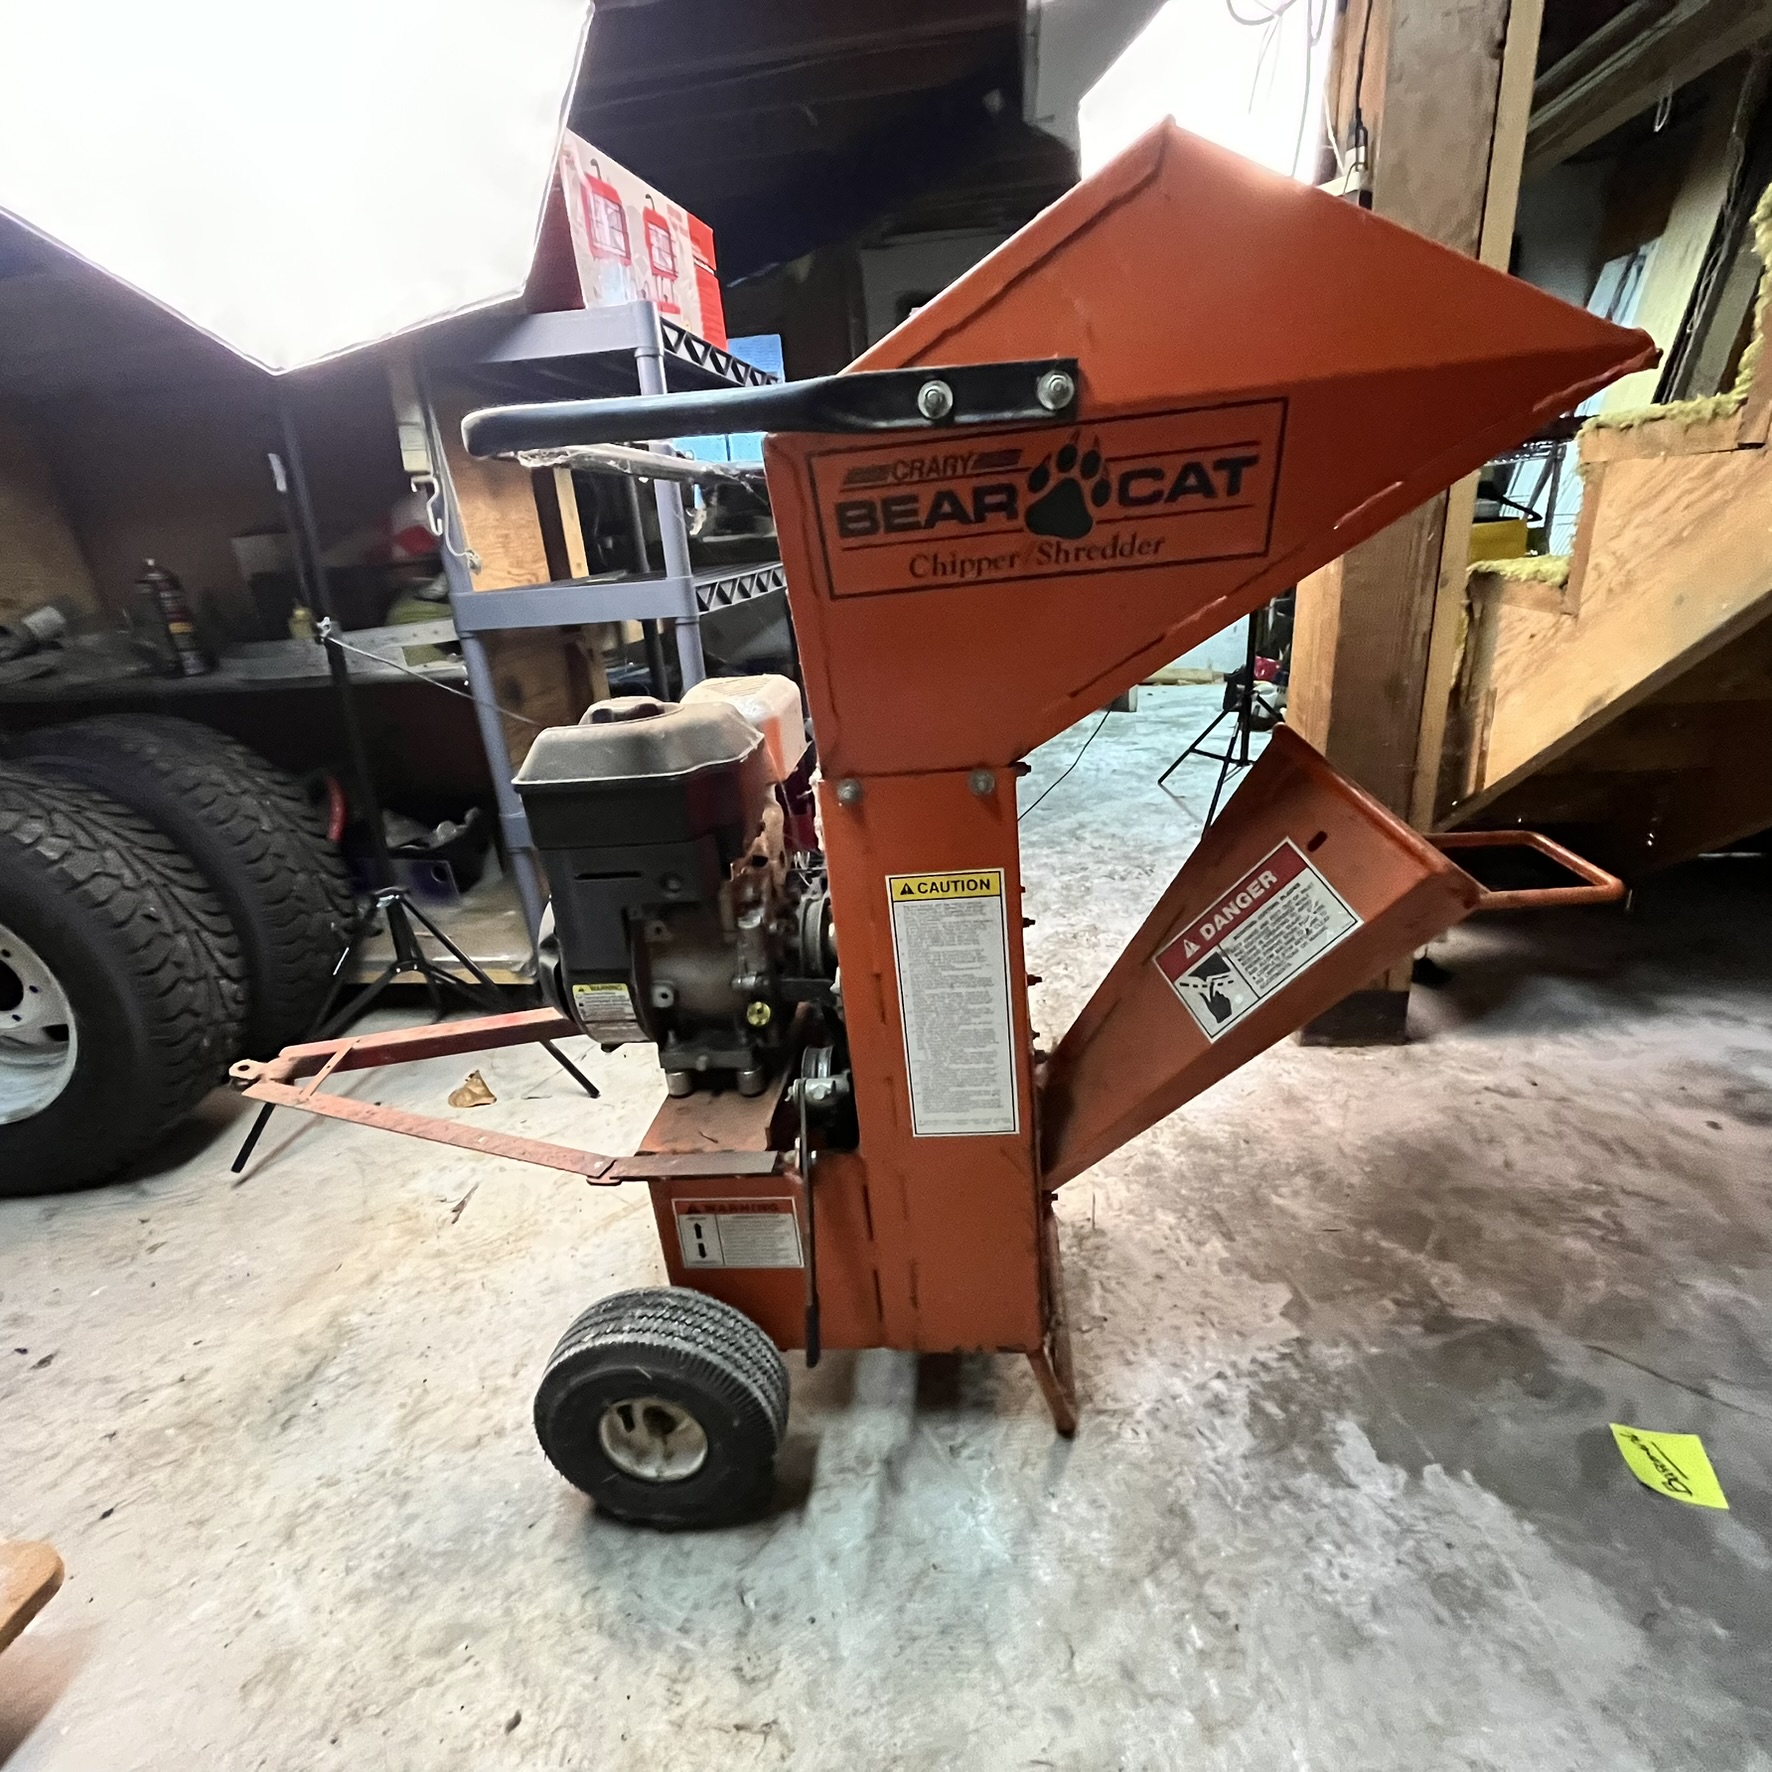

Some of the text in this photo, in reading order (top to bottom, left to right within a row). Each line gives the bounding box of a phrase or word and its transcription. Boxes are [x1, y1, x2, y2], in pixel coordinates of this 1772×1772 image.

[892, 452, 974, 482] CRARY
[835, 455, 1260, 539] BEAR CAT
[917, 878, 991, 895] CAUTION
[1199, 870, 1278, 942] DANGER
